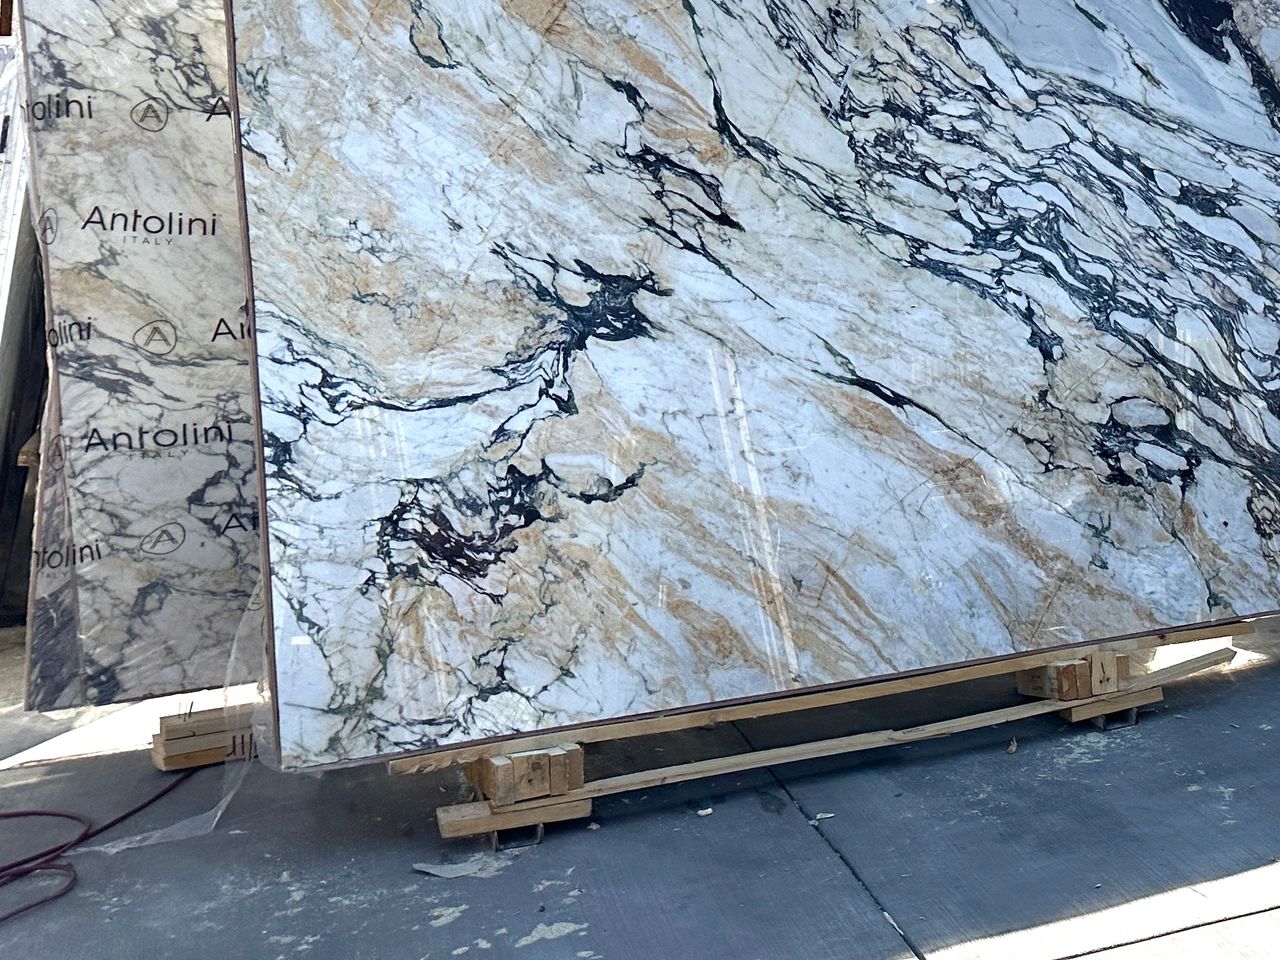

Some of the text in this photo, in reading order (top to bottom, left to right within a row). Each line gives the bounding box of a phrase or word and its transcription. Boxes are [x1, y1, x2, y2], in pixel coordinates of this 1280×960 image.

[81, 206, 217, 236] Antolini
[123, 236, 173, 245] ITALY
[85, 420, 233, 453] Antolini
